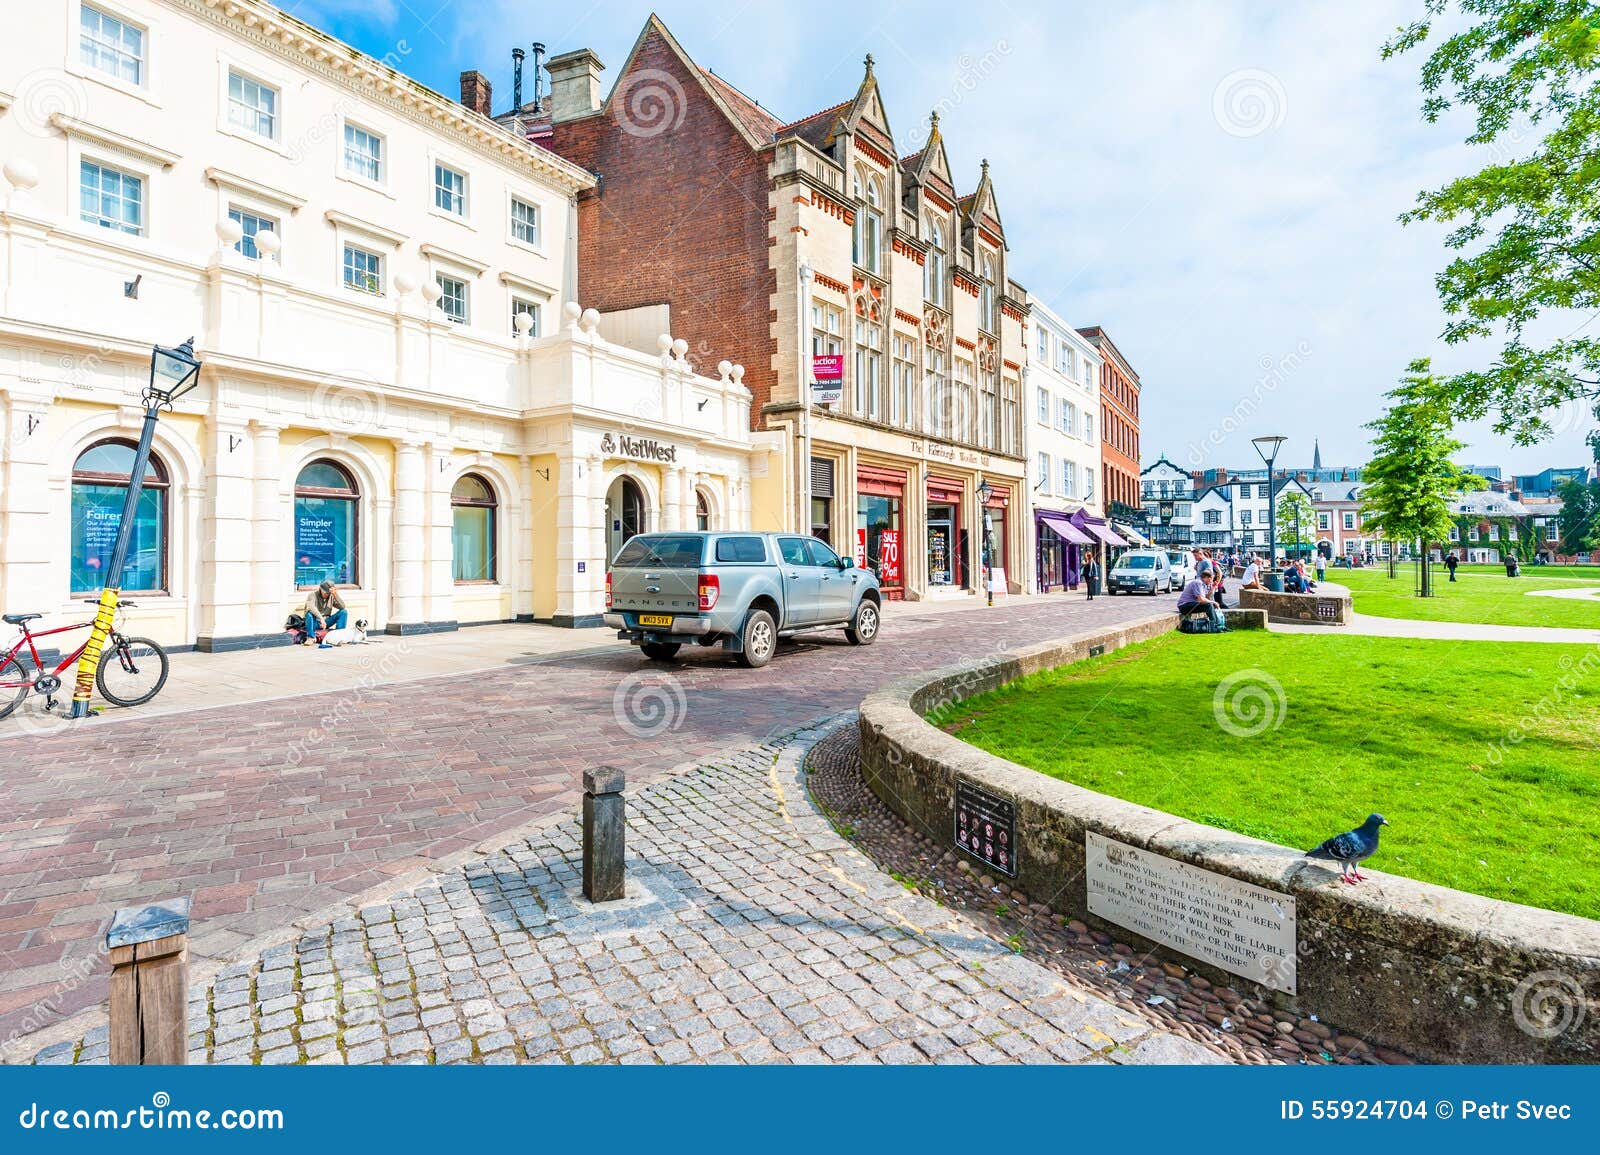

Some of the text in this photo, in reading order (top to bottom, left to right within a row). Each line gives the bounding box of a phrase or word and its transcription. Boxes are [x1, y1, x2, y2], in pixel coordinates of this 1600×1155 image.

[814, 357, 837, 365] uction
[620, 435, 677, 462] NatWest
[86, 510, 122, 520] Fairer
[300, 518, 332, 528] Simpler
[883, 532, 898, 542] SALE
[883, 543, 898, 562] 70
[615, 599, 695, 607] RANGER
[1144, 878, 1165, 893] UPON
[1167, 886, 1184, 899] THE
[1150, 890, 1157, 901] AT
[1161, 895, 1186, 911] THEIR
[1188, 904, 1209, 919] OWN
[1129, 893, 1146, 907] AND
[1147, 900, 1187, 923] CHAPTER
[1188, 916, 1210, 931] WILL
[1212, 925, 1230, 939] NOT
[1234, 932, 1246, 945] BE
[1249, 936, 1285, 959] LIABLE
[1208, 935, 1220, 947] OR
[1222, 939, 1256, 961] INJURY
